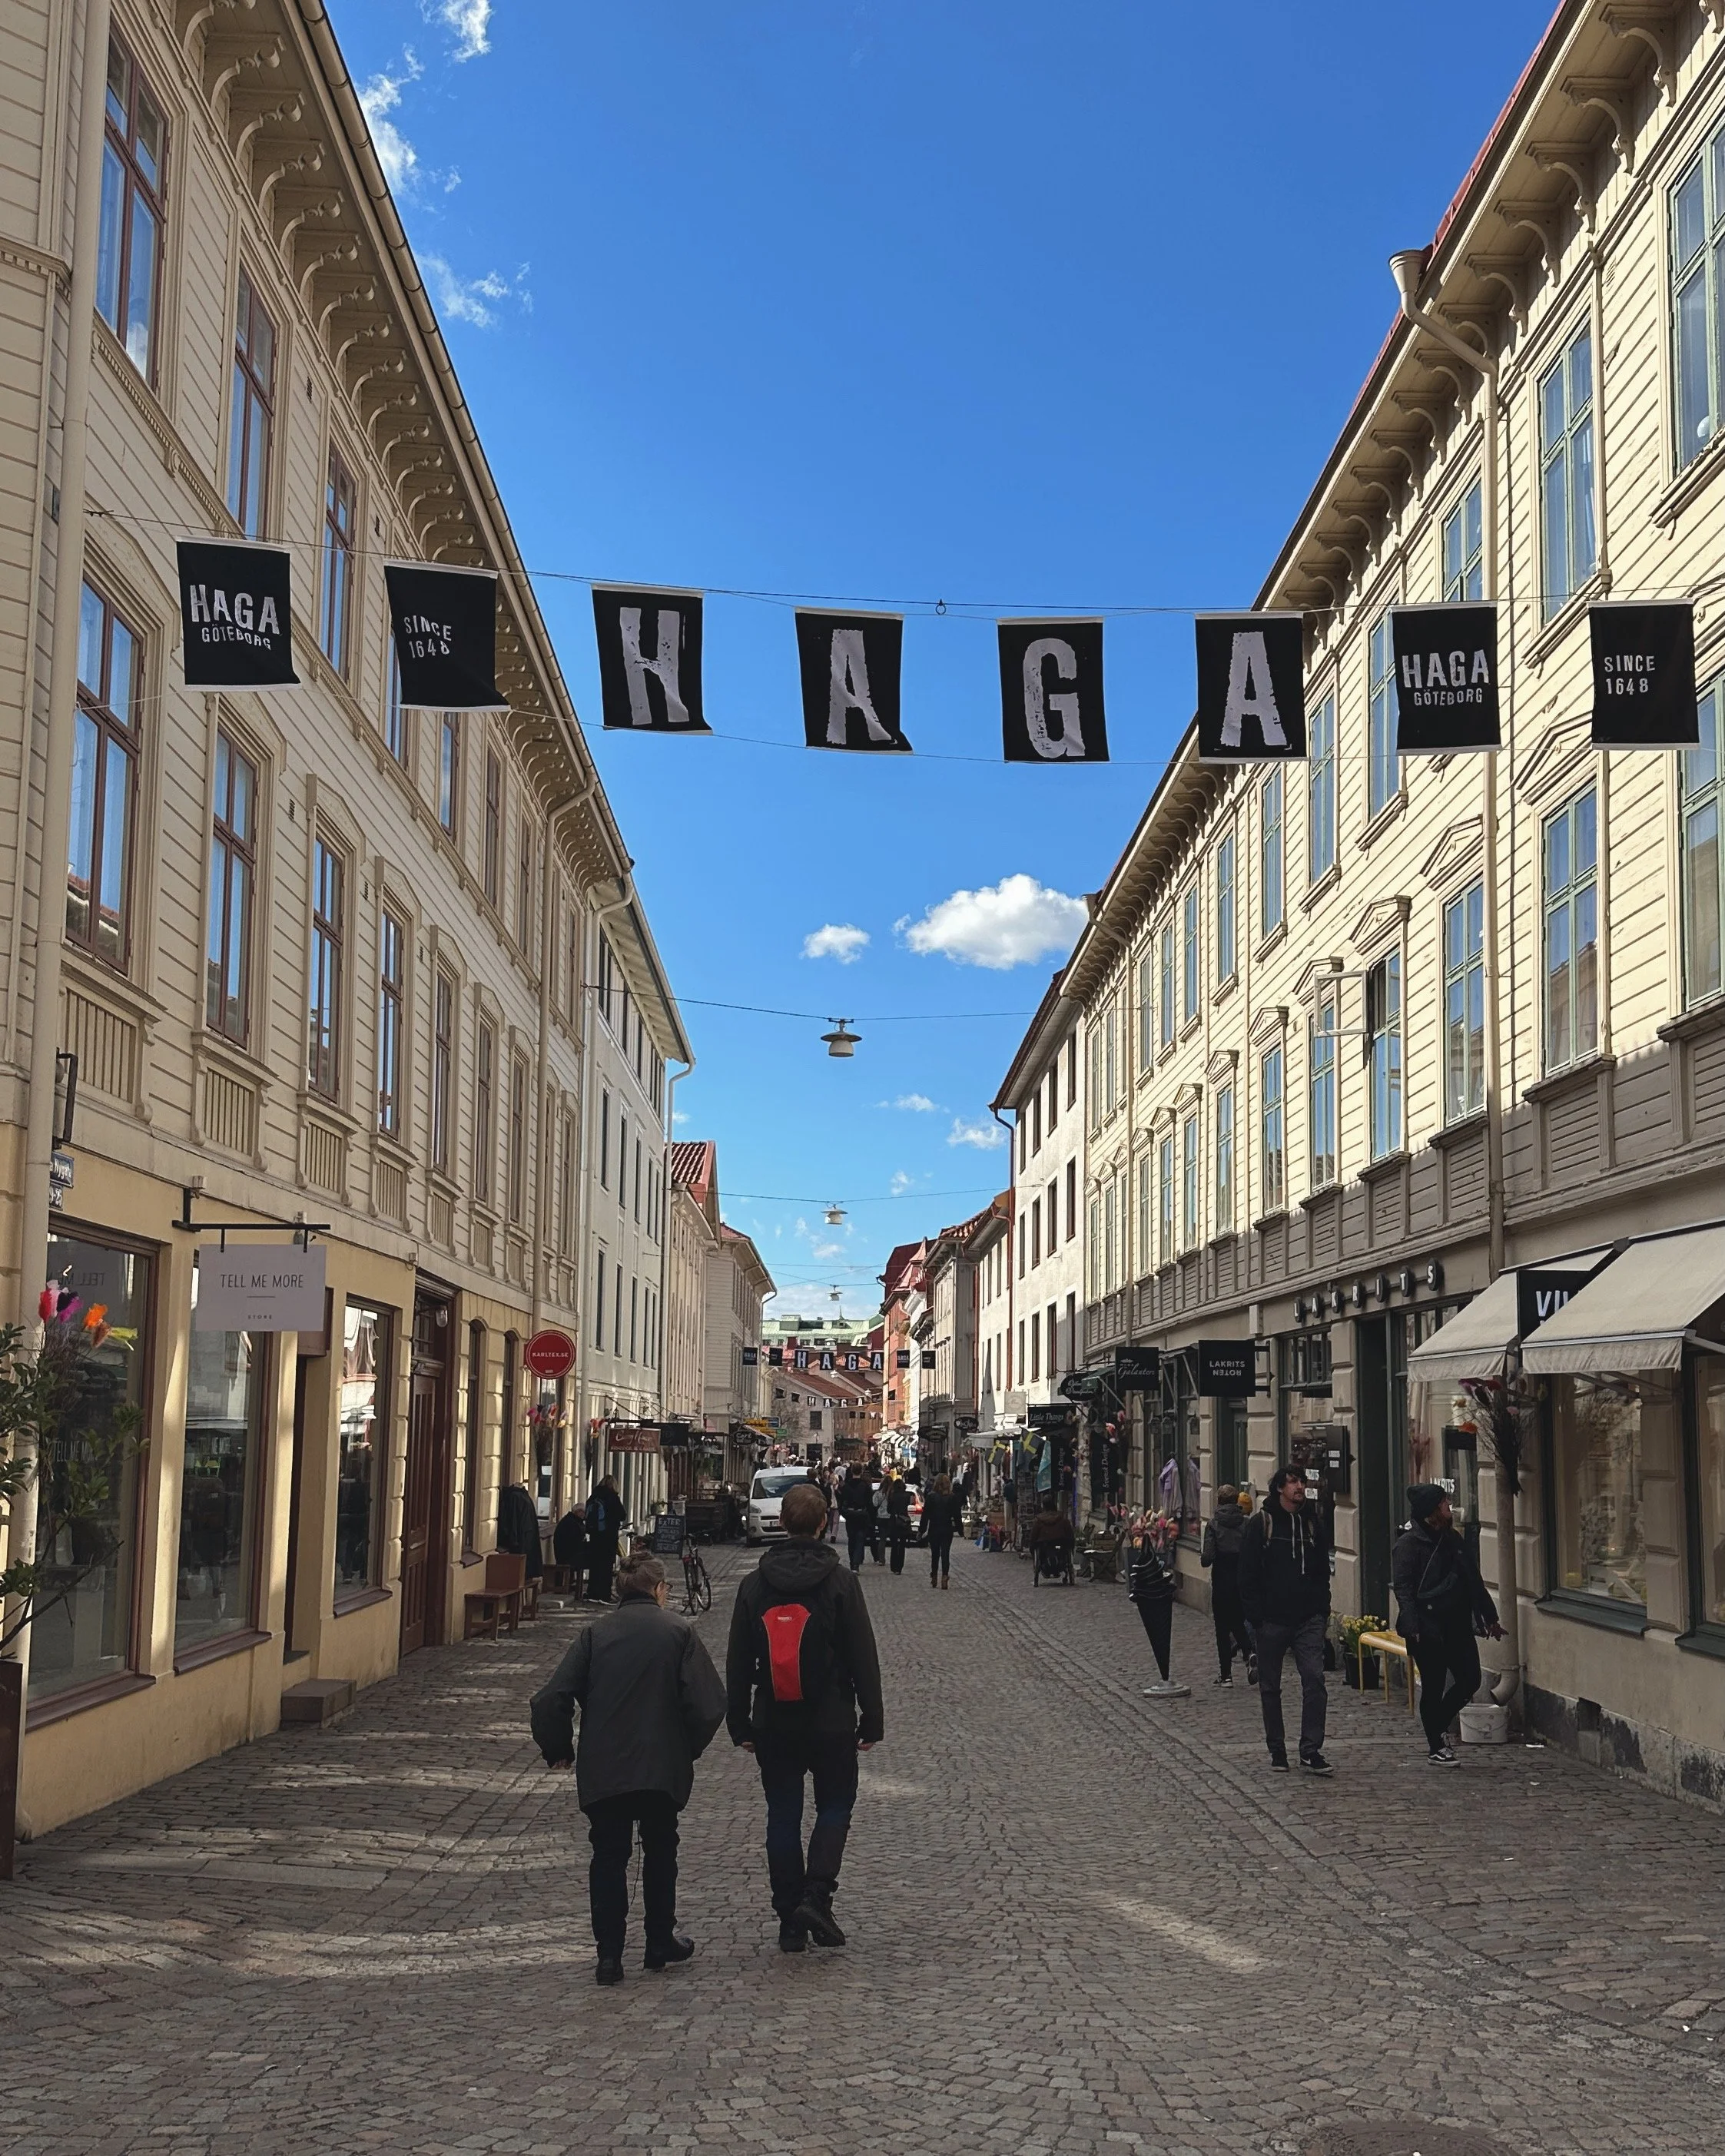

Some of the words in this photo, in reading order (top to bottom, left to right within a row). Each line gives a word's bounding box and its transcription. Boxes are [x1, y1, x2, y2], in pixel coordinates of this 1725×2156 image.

[190, 585, 280, 635] HAGA
[201, 624, 271, 651] GÖTEBORG
[403, 615, 452, 642] SINCE
[409, 639, 450, 658] 1648
[1402, 649, 1489, 688] HAGA
[1604, 655, 1656, 673] SINCE
[1414, 688, 1483, 706] GÖTEBORG
[1606, 678, 1649, 695] 1648
[221, 1274, 246, 1288] TELL
[251, 1274, 267, 1288] ME
[272, 1274, 304, 1289] MORE
[1294, 1265, 1434, 1317] LAKRITS
